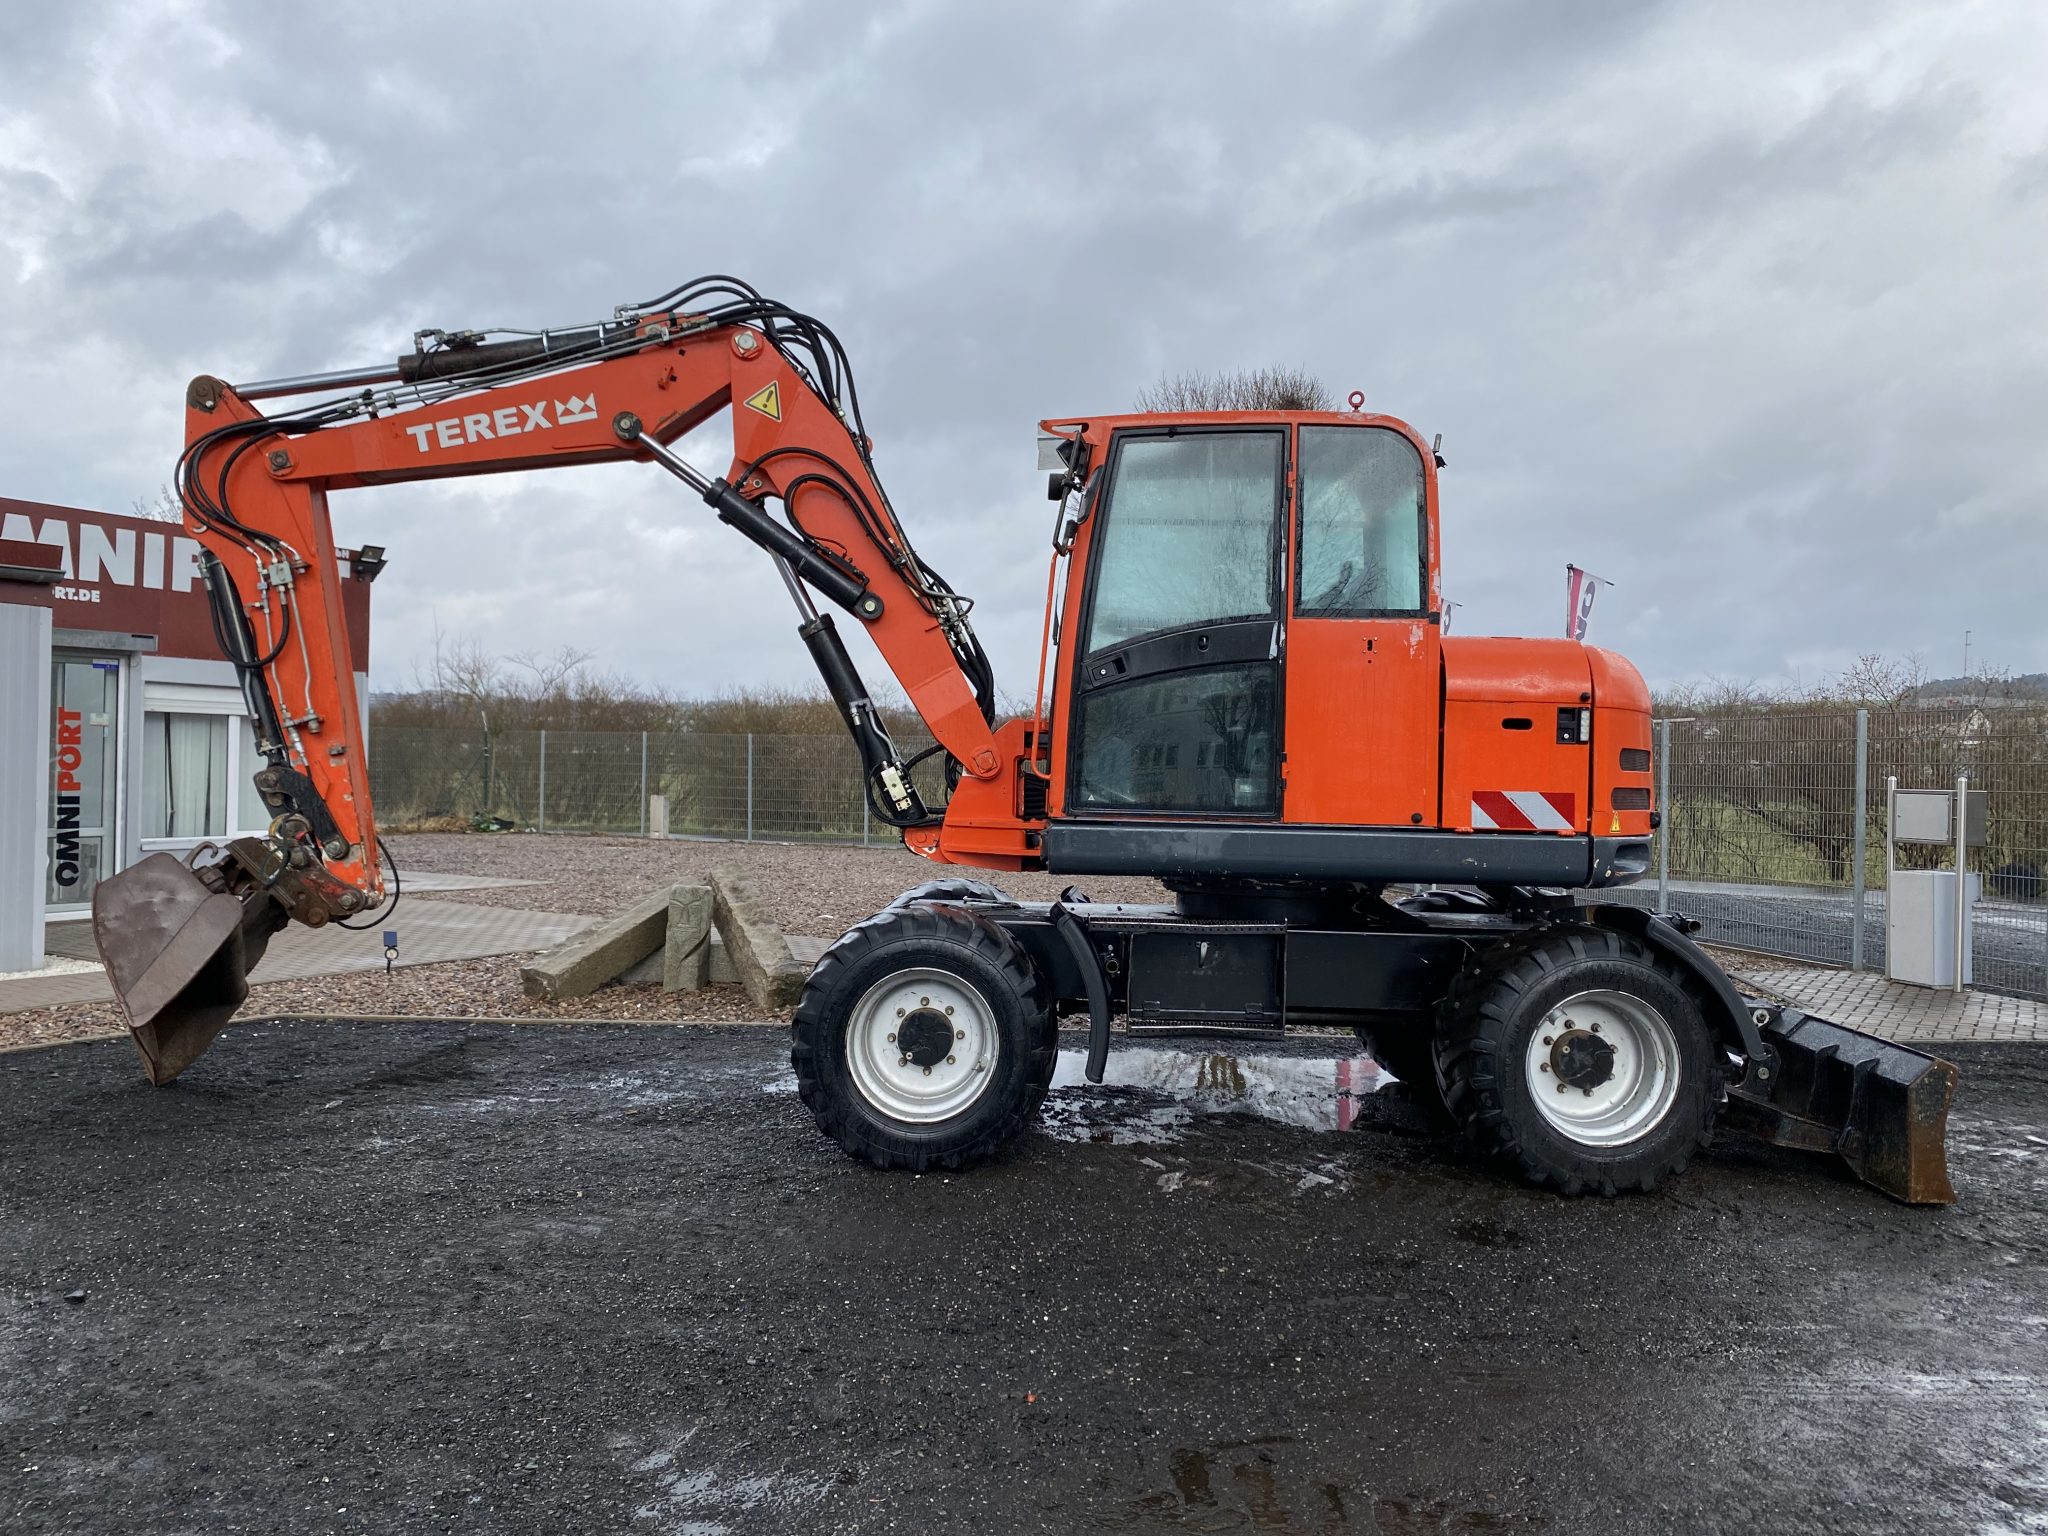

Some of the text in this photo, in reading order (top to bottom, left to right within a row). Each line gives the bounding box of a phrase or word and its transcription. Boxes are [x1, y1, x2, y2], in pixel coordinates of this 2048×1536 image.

[405, 400, 553, 453] TEREX
[51, 586, 101, 603] RT.DE
[55, 706, 82, 887] OMNIPORT
